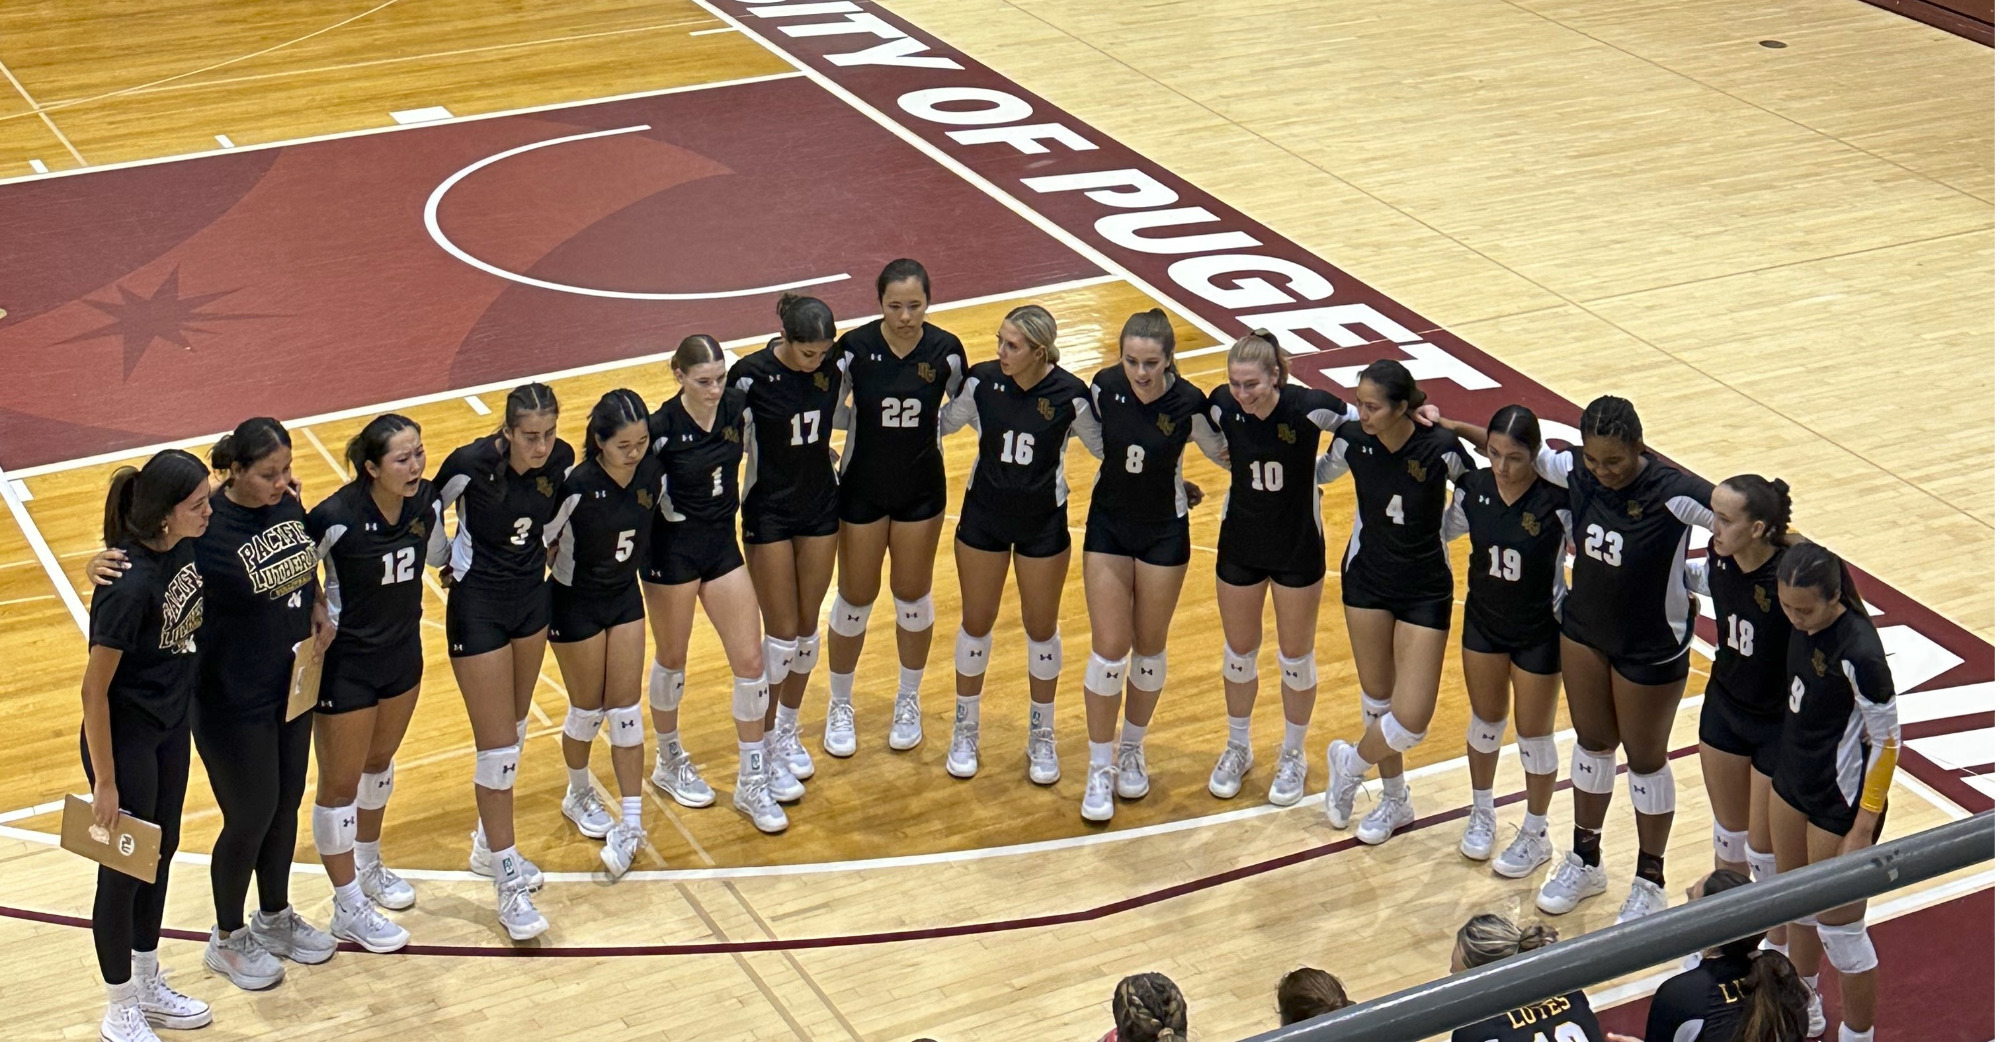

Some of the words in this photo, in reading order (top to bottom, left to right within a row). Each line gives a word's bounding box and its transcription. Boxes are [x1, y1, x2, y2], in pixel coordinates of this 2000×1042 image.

[735, 0, 965, 69] ITY
[897, 87, 1100, 155] OF
[1020, 168, 1502, 391] PUGET
[790, 410, 821, 446] 17
[881, 397, 922, 428] 22
[1000, 430, 1035, 466] 16
[1125, 444, 1145, 474] 8
[711, 466, 723, 497] 1
[1249, 461, 1284, 492] 10
[1385, 494, 1405, 525] 4
[510, 517, 532, 545] 3
[614, 529, 636, 562] 5
[1585, 523, 1624, 567] 23
[381, 547, 415, 585] 12
[1489, 545, 1521, 581] 19
[1727, 613, 1754, 657] 18
[1789, 675, 1805, 714] 9
